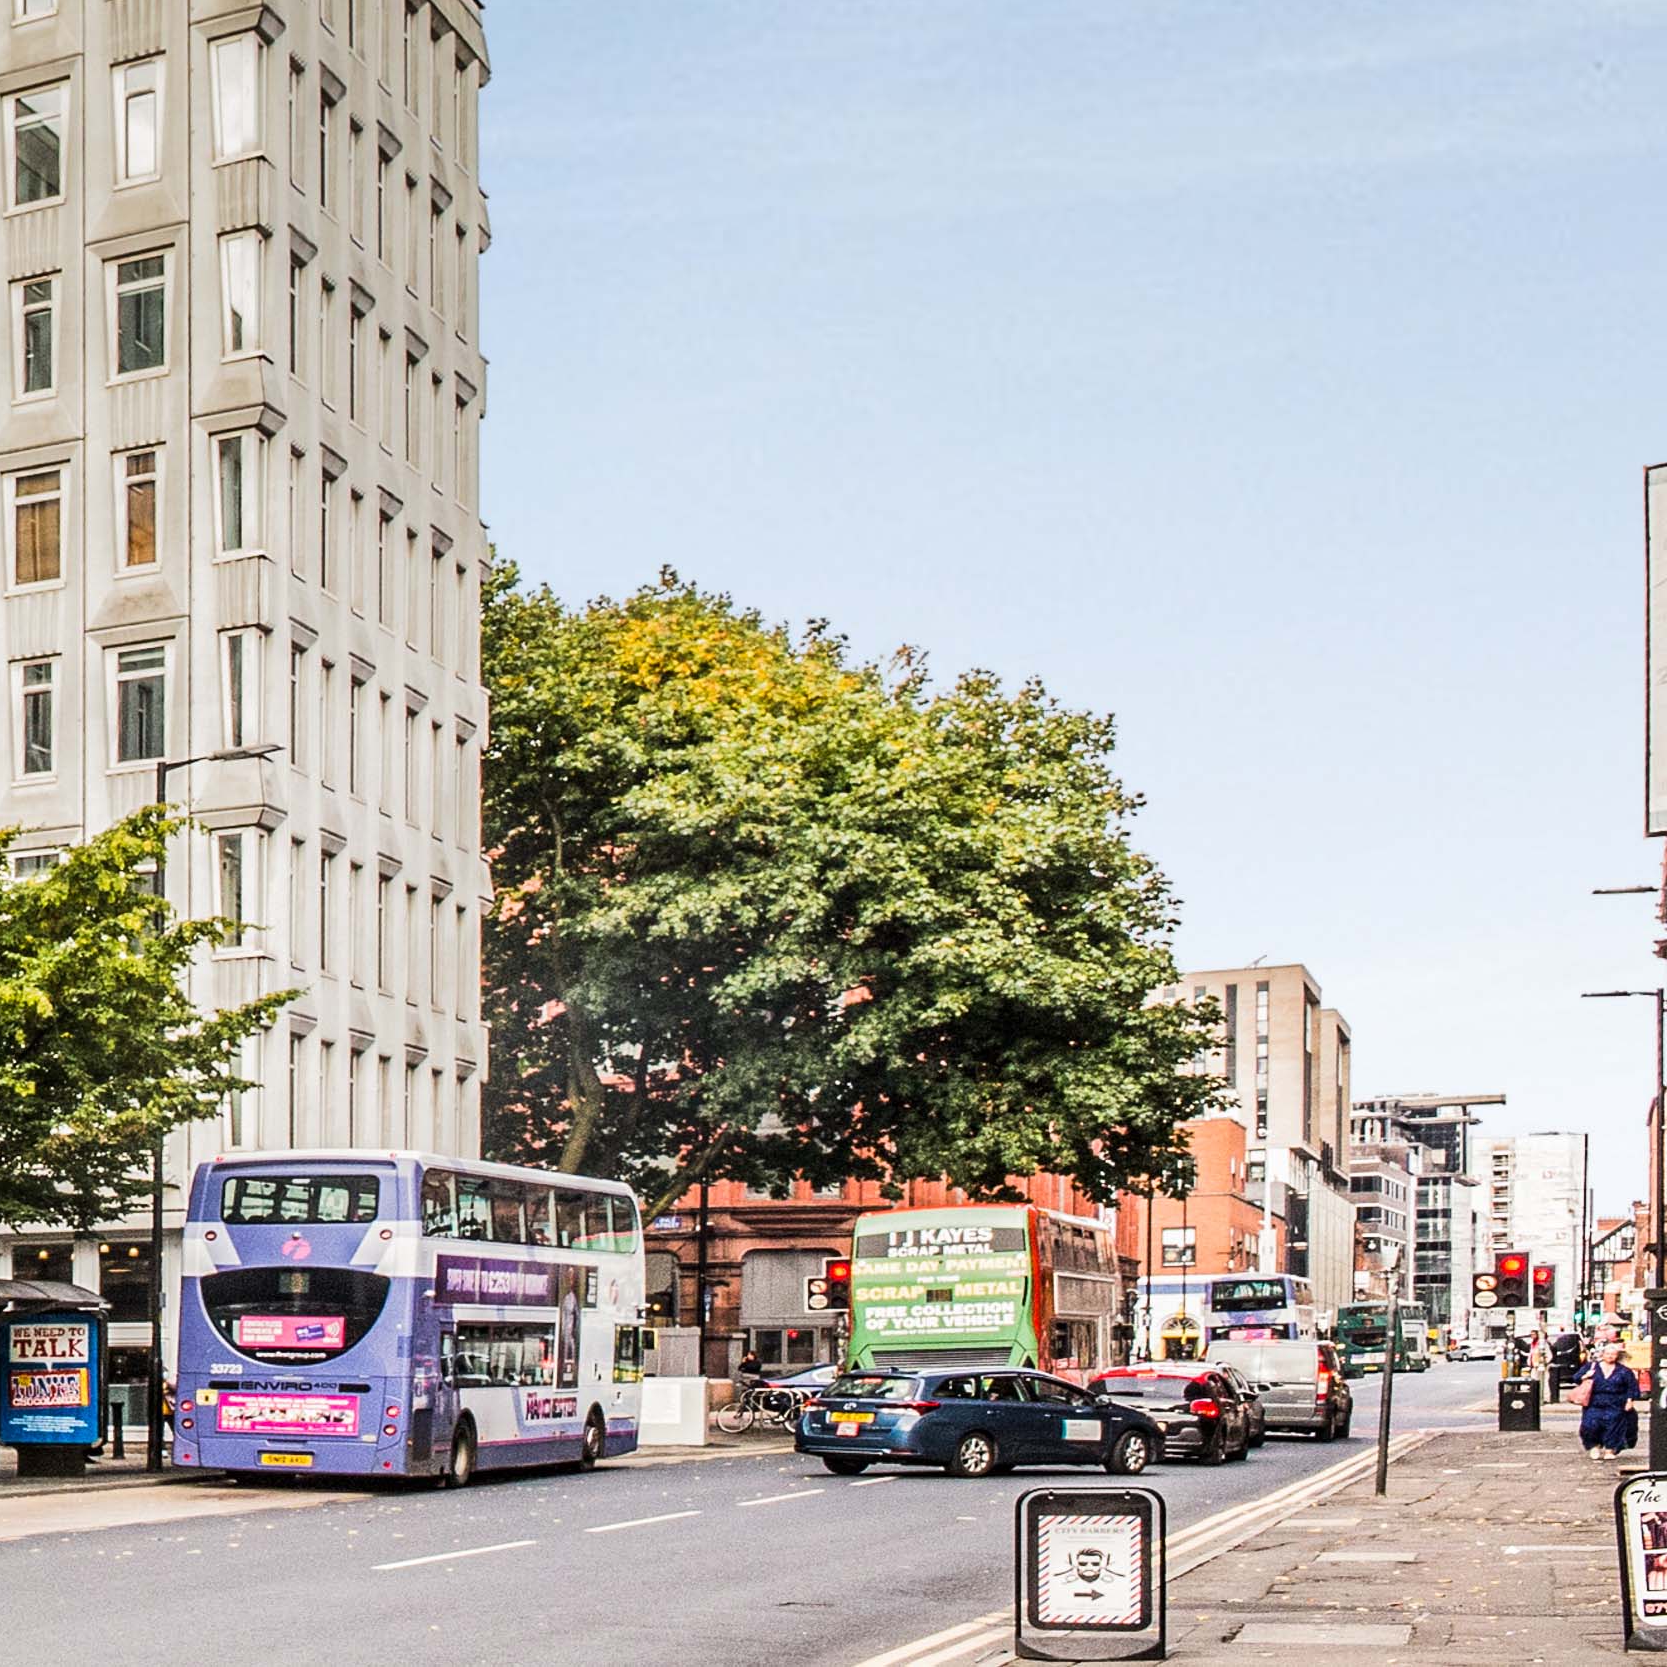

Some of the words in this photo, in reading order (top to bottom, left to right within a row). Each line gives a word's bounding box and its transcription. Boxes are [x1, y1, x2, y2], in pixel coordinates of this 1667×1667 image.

[920, 1226, 993, 1244] KAYES
[887, 1245, 940, 1258] SCRAP
[942, 1243, 993, 1255] METAL
[852, 1260, 901, 1276] SAME
[906, 1260, 940, 1273] DAY
[945, 1257, 1028, 1271] PAYMENT
[856, 1285, 925, 1301] SCRAP
[955, 1282, 1021, 1297] METAL
[865, 1306, 907, 1318] FREE
[911, 1302, 1015, 1316] COLLECTION
[865, 1318, 888, 1330] OF
[893, 1316, 940, 1329] YOUR
[943, 1314, 1015, 1327] VEHICLE
[13, 1328, 30, 1337] WE
[33, 1327, 65, 1337] NEED
[68, 1327, 85, 1336] TO
[13, 1339, 84, 1358] TALK
[241, 1381, 312, 1391] ENVIRO
[1630, 1490, 1661, 1504] The
